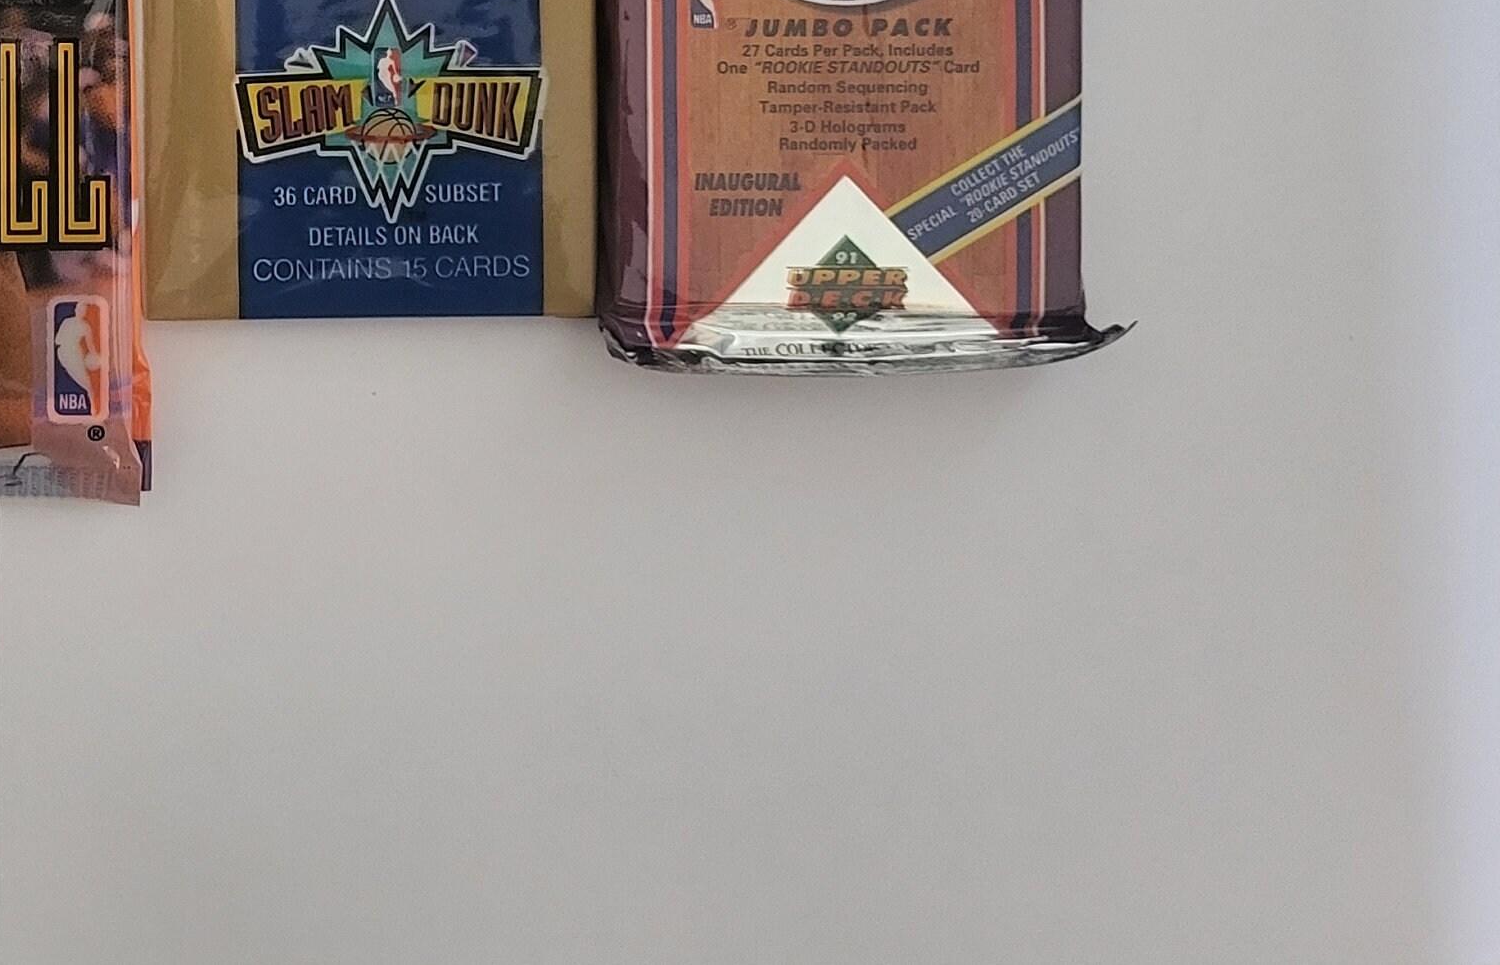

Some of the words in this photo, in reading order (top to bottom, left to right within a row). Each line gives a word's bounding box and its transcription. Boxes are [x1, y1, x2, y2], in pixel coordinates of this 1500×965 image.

[693, 13, 713, 25] NBA
[744, 18, 854, 38] JUMBO
[869, 17, 954, 37] PACK
[742, 44, 760, 57] 27
[765, 44, 808, 58] Cards
[813, 44, 839, 57] Per
[843, 43, 884, 59] Pack,
[888, 43, 955, 57] Includes
[716, 61, 748, 75] One
[943, 60, 981, 74] Card
[767, 81, 832, 94] Random
[835, 80, 928, 97] Sequencing
[256, 82, 354, 144] SLAM
[432, 81, 521, 142] DUNK
[759, 100, 896, 115] Tamper-Resistant
[900, 100, 937, 114] Pack
[789, 120, 816, 134] 3-D
[820, 120, 906, 136] Holograms
[779, 137, 856, 153] Randomly
[863, 137, 917, 151] Packed
[950, 161, 1001, 197] COLLECT
[1001, 144, 1027, 167] THE
[694, 172, 802, 191] INAUGURAL
[273, 186, 297, 206] 36
[303, 185, 357, 206] CARD
[425, 183, 502, 203] SUBSET
[966, 186, 1019, 224] 20-CARD
[1019, 172, 1042, 193] SET
[708, 198, 784, 217] EDITION
[907, 205, 958, 241] SPECIAL
[308, 226, 387, 247] DETAILS
[394, 225, 422, 245] ON
[429, 224, 479, 244] BACK
[253, 258, 391, 282] CONTAINS
[402, 257, 428, 279] 15
[434, 255, 530, 278] CARDS
[786, 268, 908, 287] UPPER
[58, 393, 88, 412] NBA
